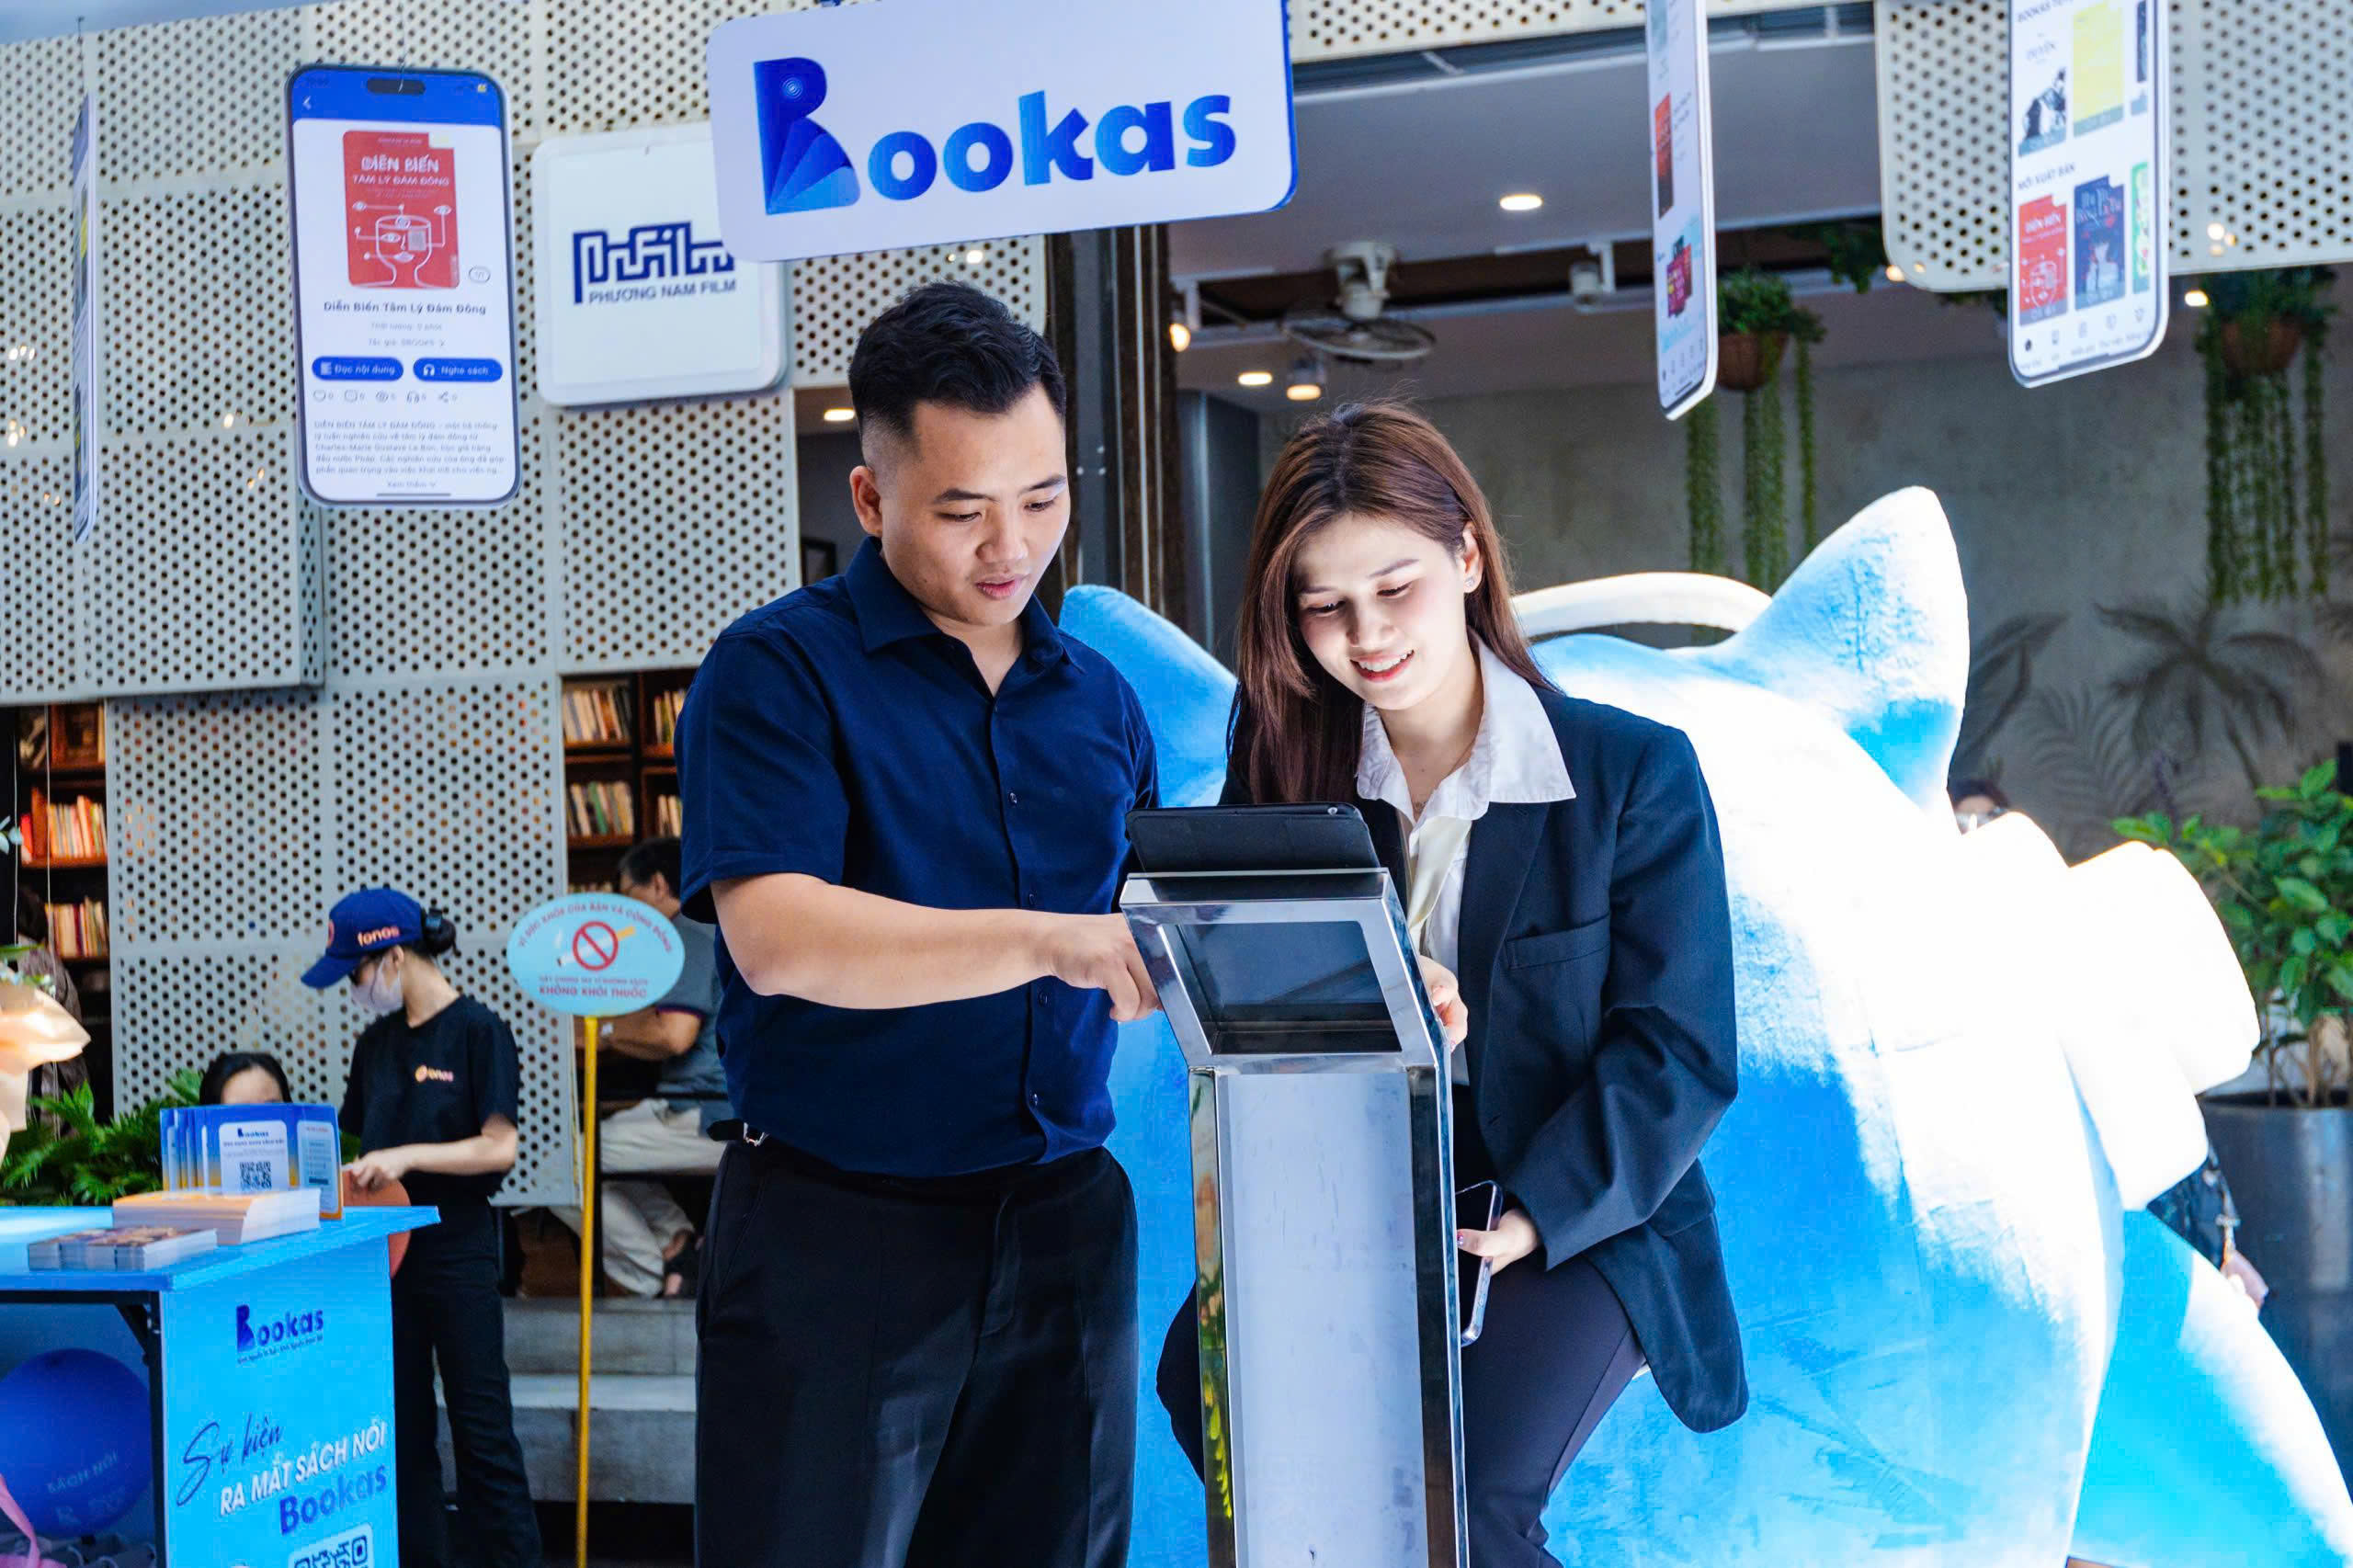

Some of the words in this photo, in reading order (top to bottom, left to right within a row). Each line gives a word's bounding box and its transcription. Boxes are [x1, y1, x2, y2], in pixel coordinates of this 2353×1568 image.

[754, 56, 1236, 215] Bookas
[661, 282, 696, 299] NAM
[699, 279, 736, 295] FILM
[382, 302, 407, 312] Tâm
[410, 302, 423, 315] Lý
[358, 926, 401, 948] fonos
[540, 984, 577, 996] KHÔNG
[235, 1303, 324, 1353] Bookas
[220, 1481, 245, 1517] RA
[250, 1452, 292, 1504] MẮT
[295, 1436, 348, 1484] SÁCH
[352, 1415, 388, 1460] NÓI
[278, 1463, 388, 1537] Bookas
